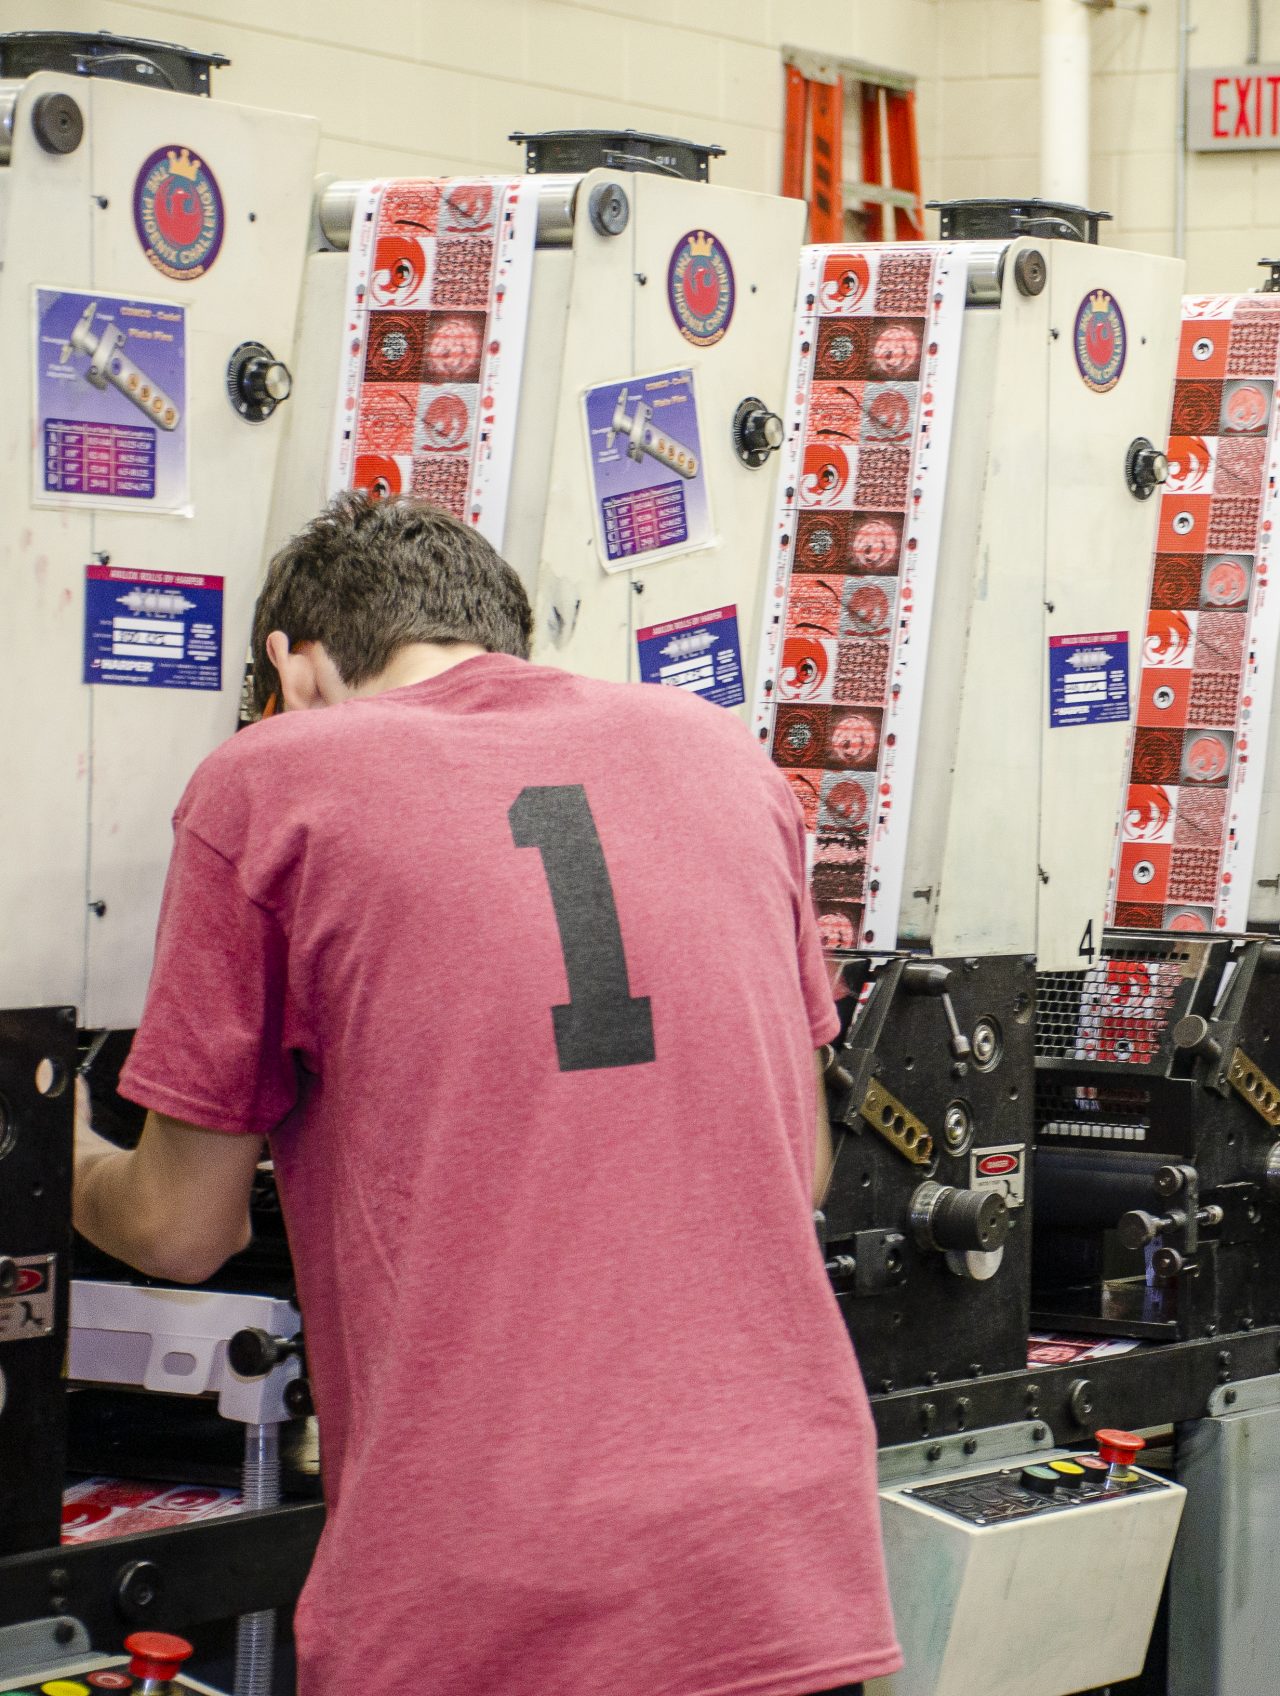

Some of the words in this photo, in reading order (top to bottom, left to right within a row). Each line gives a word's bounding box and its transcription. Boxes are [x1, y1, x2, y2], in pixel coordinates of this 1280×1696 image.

[100, 658, 154, 672] HARPER
[507, 783, 656, 1072] 1
[1079, 919, 1095, 965] 4
